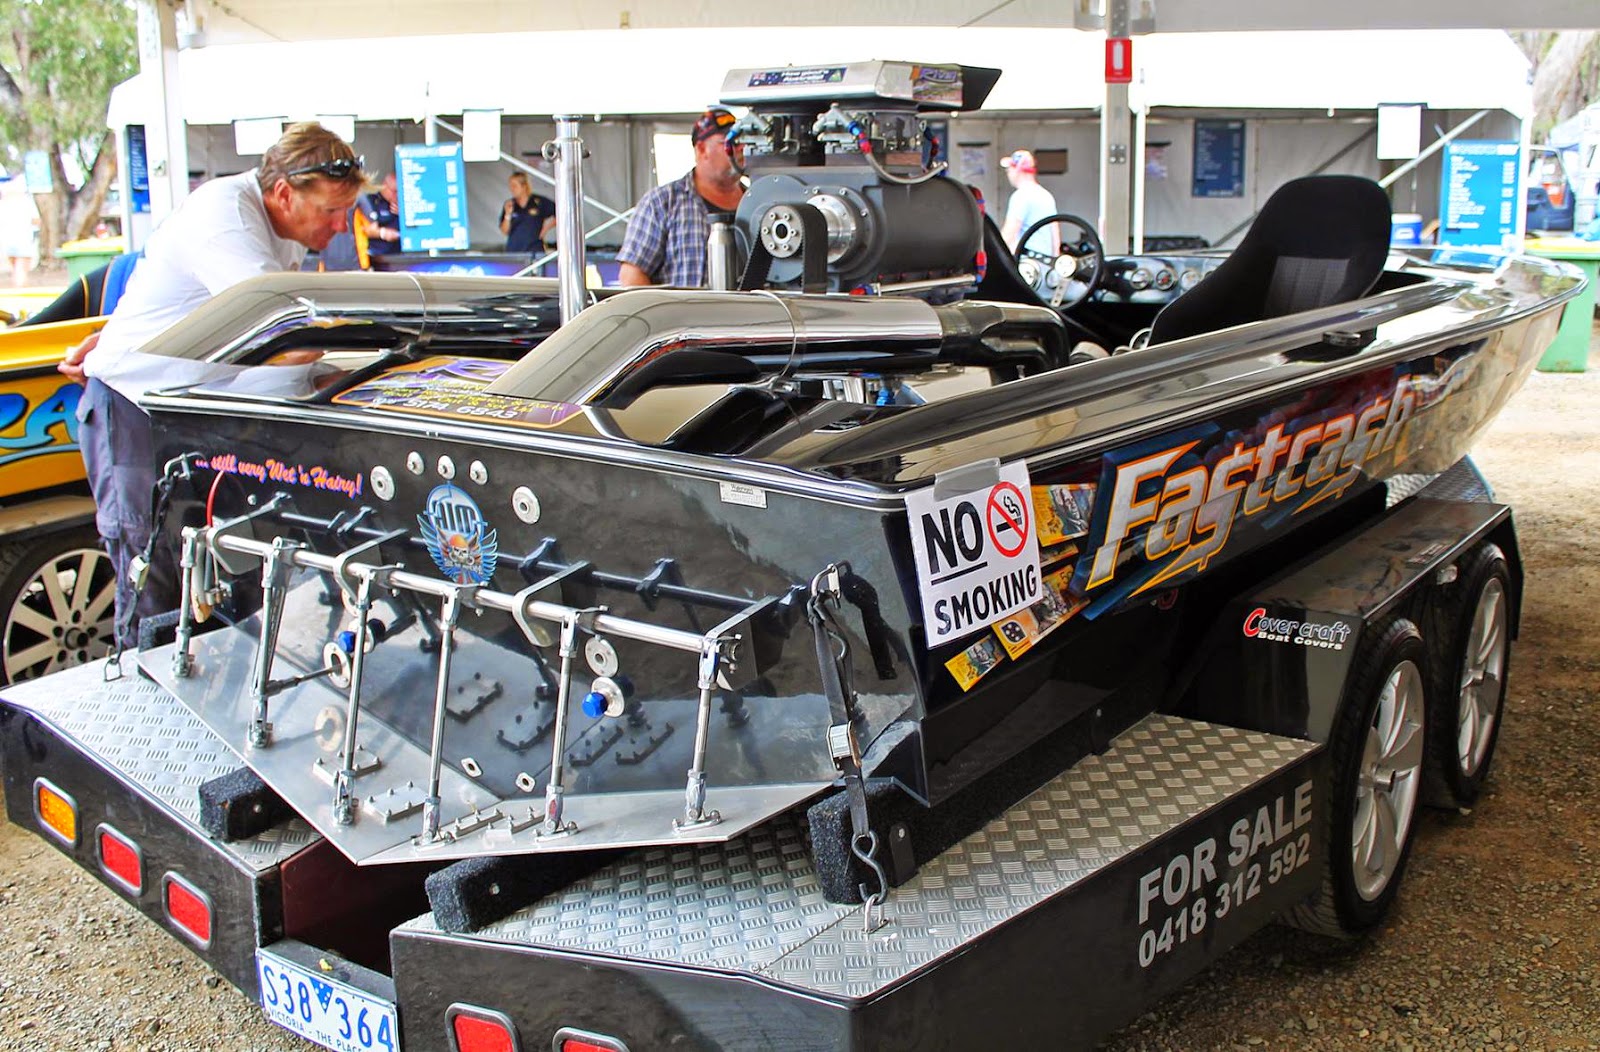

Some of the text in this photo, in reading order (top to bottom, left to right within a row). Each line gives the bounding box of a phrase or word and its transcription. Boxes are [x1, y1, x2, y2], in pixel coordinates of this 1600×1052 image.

[457, 406, 518, 418] 6843
[211, 454, 237, 474] still
[238, 461, 266, 484] very
[266, 459, 297, 484] Wet
[310, 466, 363, 499] Hairy!
[921, 500, 984, 575] NO
[934, 564, 1037, 635] SMOKING
[1257, 631, 1343, 650] Boat Covers
[1138, 780, 1313, 925] FOR SALE
[1138, 832, 1311, 968] 0418 312 592
[269, 1007, 305, 1033] VICTORIA
[315, 1030, 332, 1045] THE
